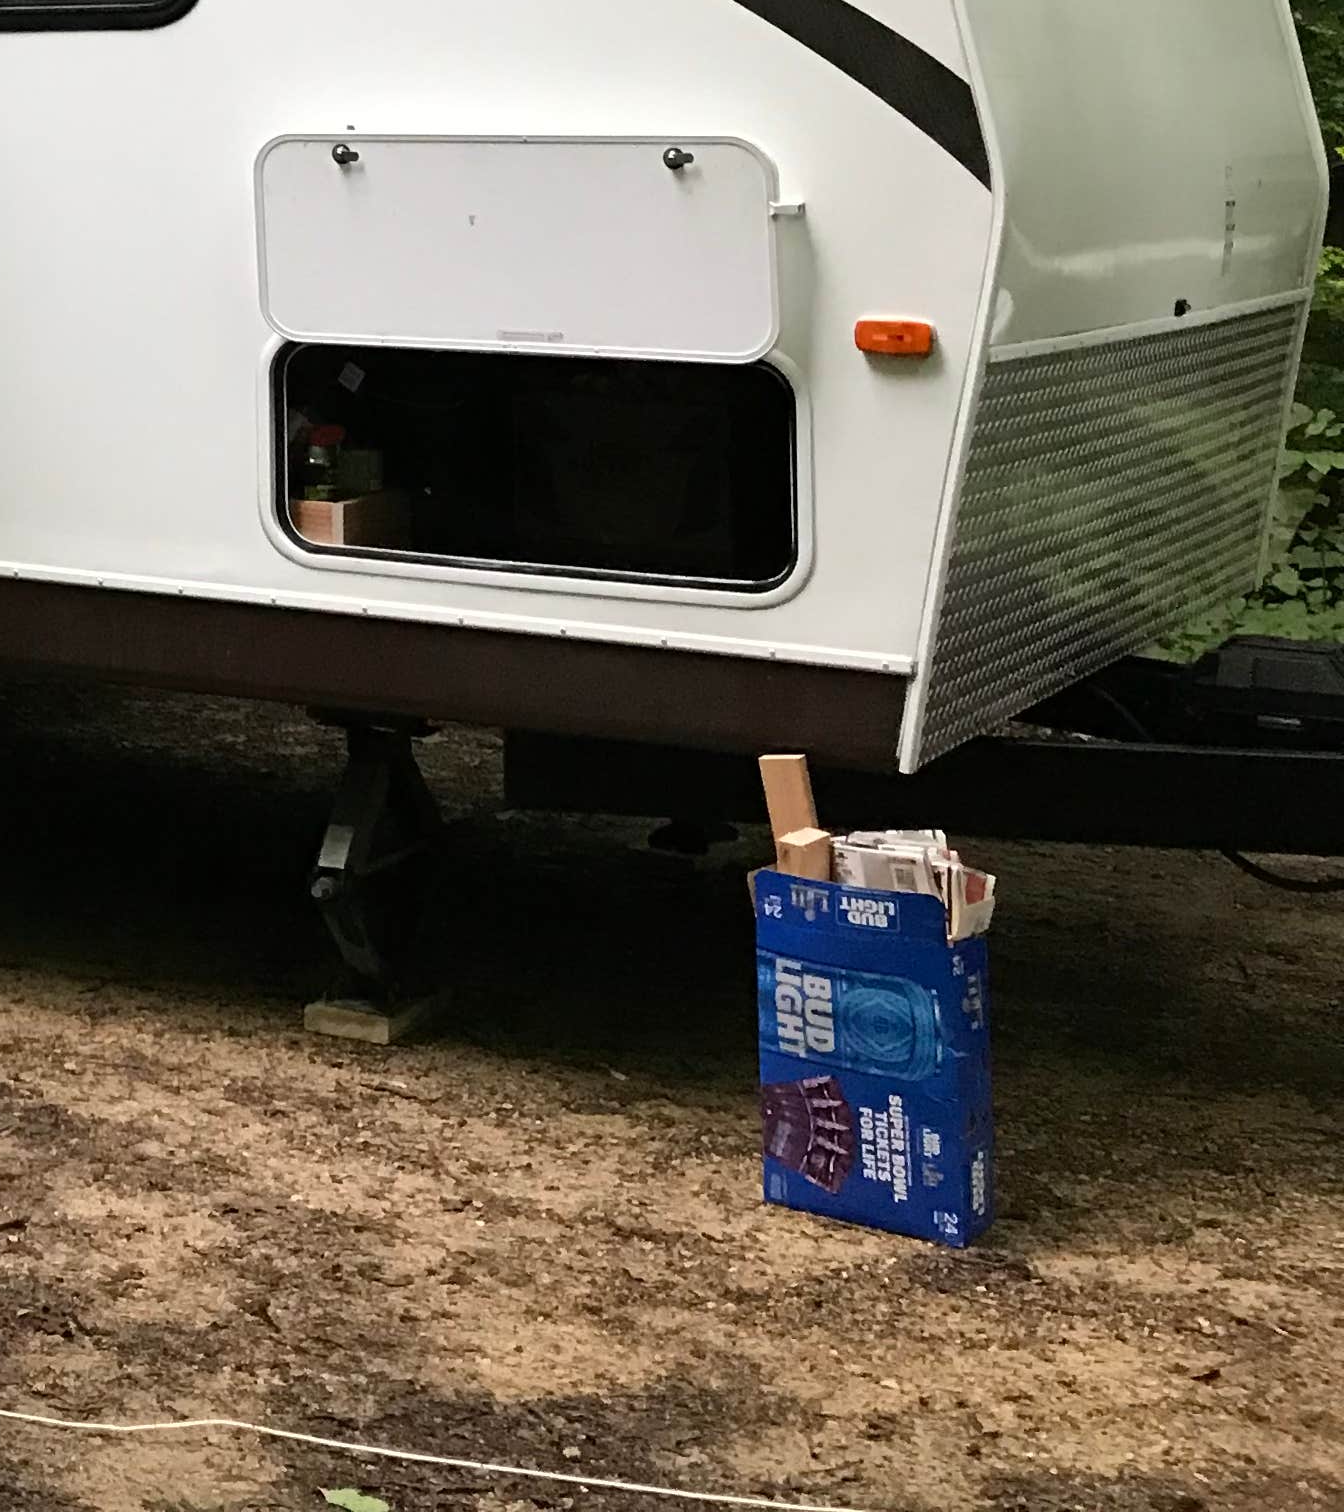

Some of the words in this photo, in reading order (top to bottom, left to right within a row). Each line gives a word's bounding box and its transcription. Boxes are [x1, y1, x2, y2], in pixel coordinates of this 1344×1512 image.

[839, 896, 895, 916] LIGHT
[847, 911, 888, 928] BUD
[775, 958, 807, 1059] LIGHT
[803, 974, 835, 1052] BUD
[858, 1106, 875, 1141] FOR
[889, 1094, 905, 1152] SUPER
[861, 1143, 878, 1181] LIFE
[874, 1111, 892, 1182] TICKETS
[891, 1154, 908, 1203] BOWL
[944, 1212, 959, 1235] 24
